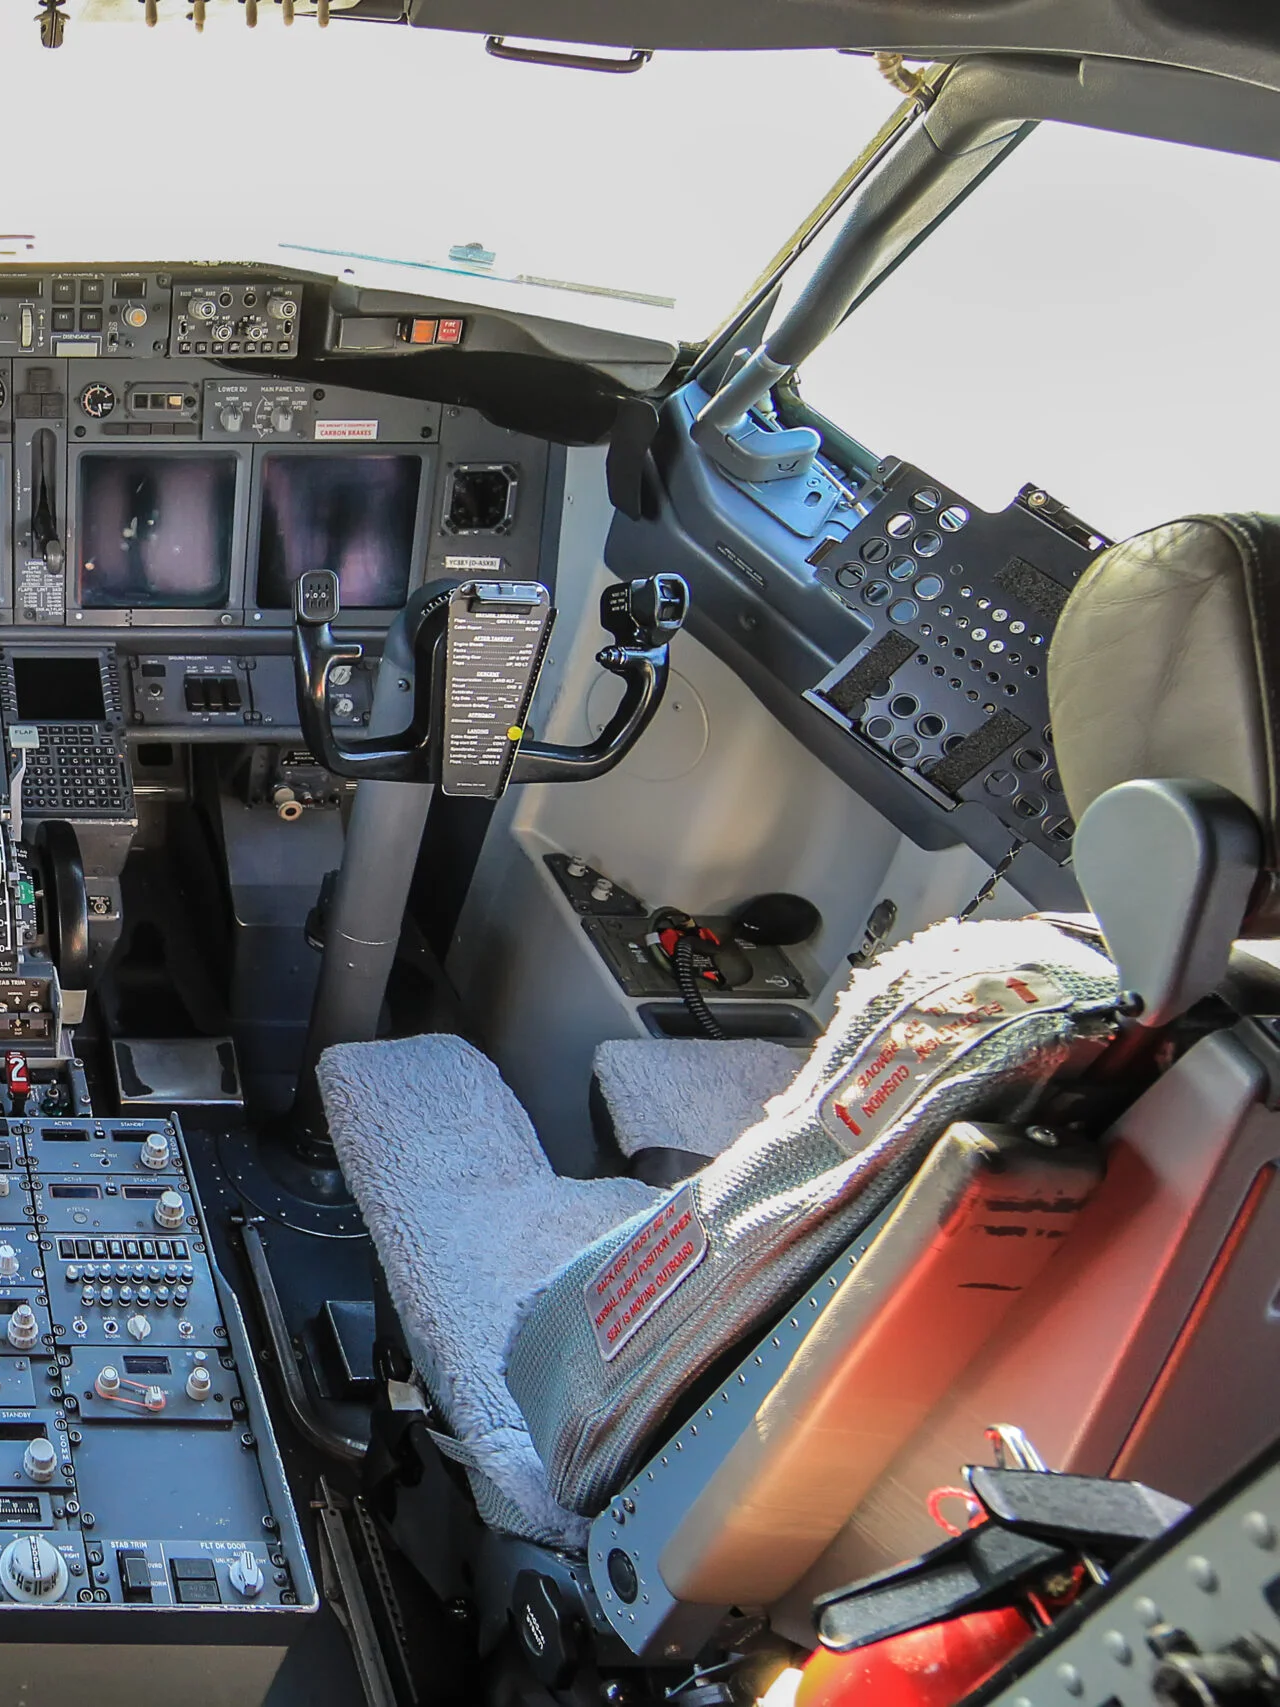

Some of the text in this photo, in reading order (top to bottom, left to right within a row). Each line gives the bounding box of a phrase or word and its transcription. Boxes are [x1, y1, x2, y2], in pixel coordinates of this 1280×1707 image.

[9, 1057, 27, 1082] 2
[857, 1039, 900, 1090] REMOVE
[860, 1064, 910, 1119] CUSHION
[35, 1194, 43, 1211] NAV
[594, 1210, 692, 1330] NORMAL FLIGHT POSITION WHEN
[596, 1203, 676, 1296] BACK REST MUST BE IN
[606, 1241, 694, 1343] SEAT IS MOVING OUTBOARD
[60, 1435, 69, 1460] COMM
